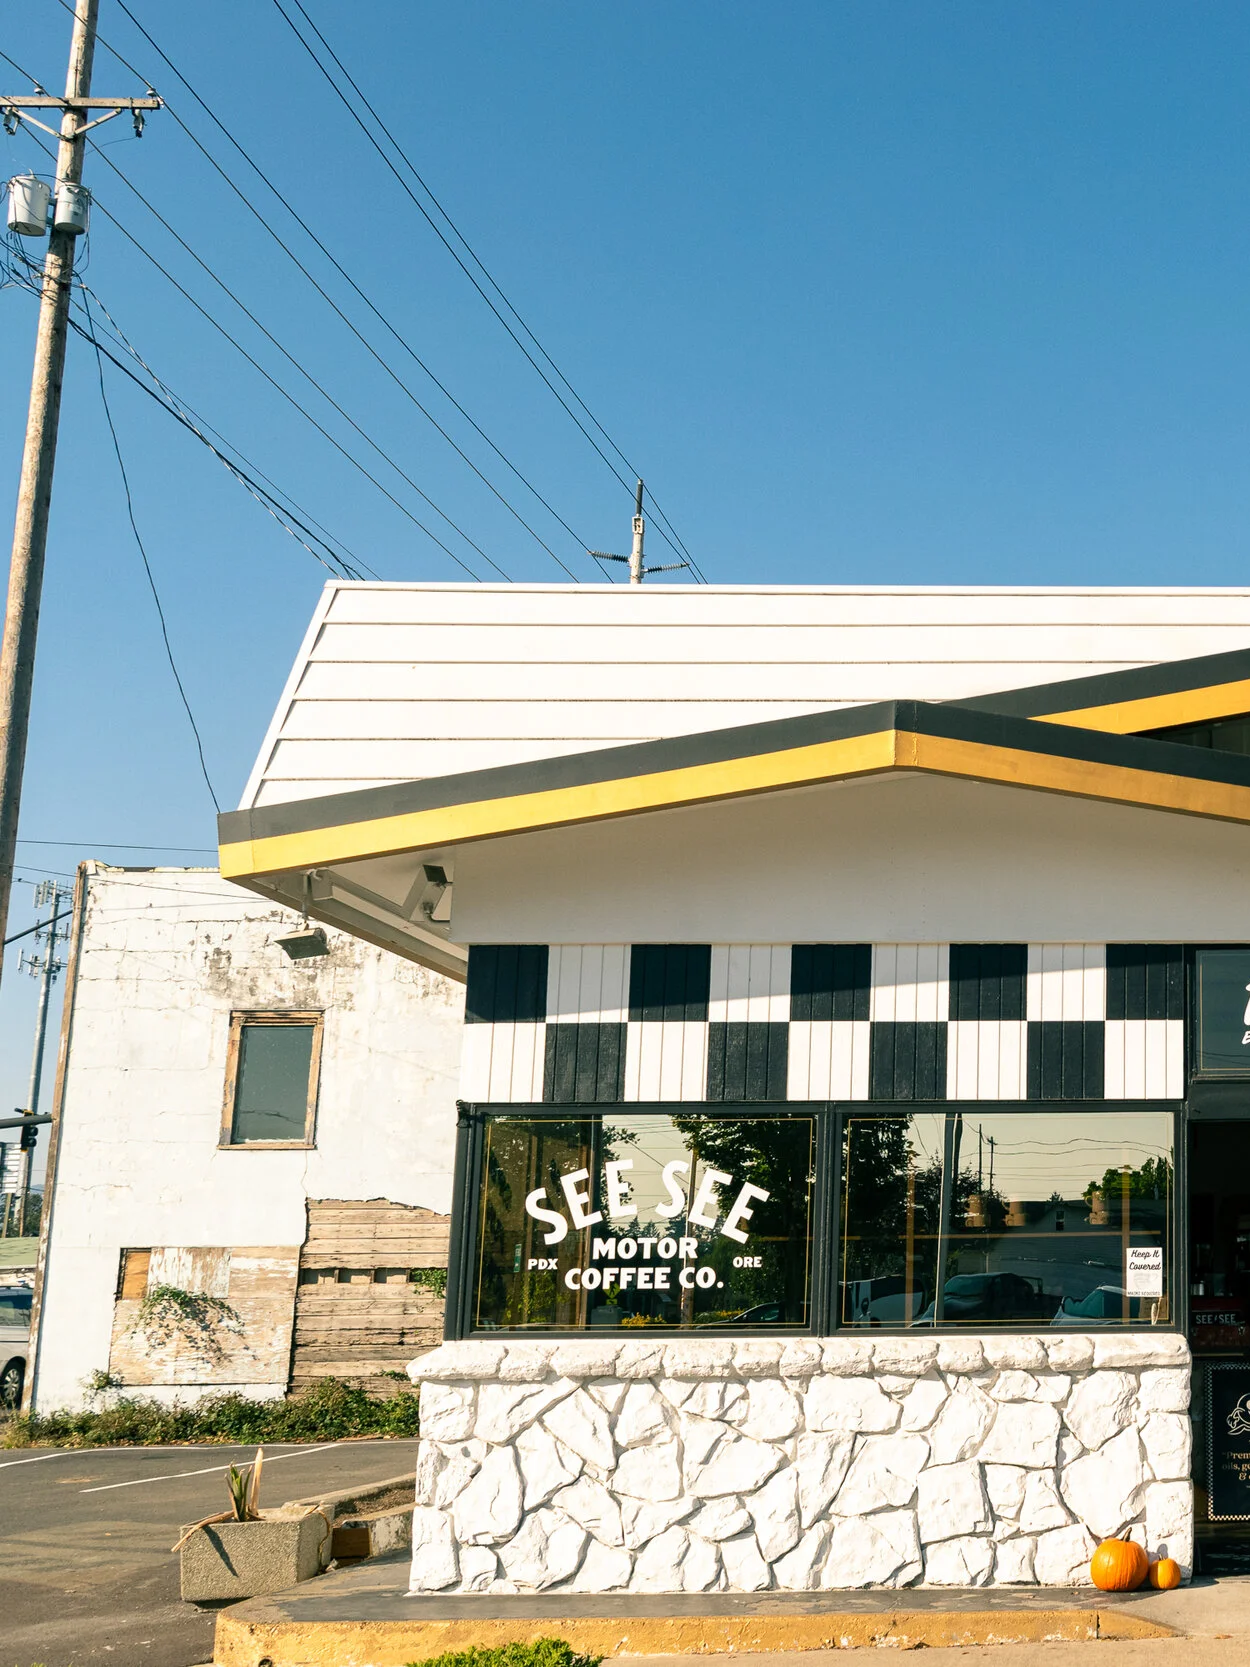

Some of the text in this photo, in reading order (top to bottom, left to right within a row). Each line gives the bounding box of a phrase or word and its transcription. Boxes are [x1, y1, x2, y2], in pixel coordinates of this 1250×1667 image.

[525, 1158, 771, 1245] SEE SEE
[592, 1236, 699, 1260] MOTOR
[1131, 1249, 1151, 1259] Keep
[527, 1258, 558, 1270] PDX
[732, 1256, 763, 1268] ORE
[1129, 1261, 1162, 1271] Covered
[564, 1266, 724, 1290] COFFEE CO.
[1238, 1471, 1247, 1481] &
